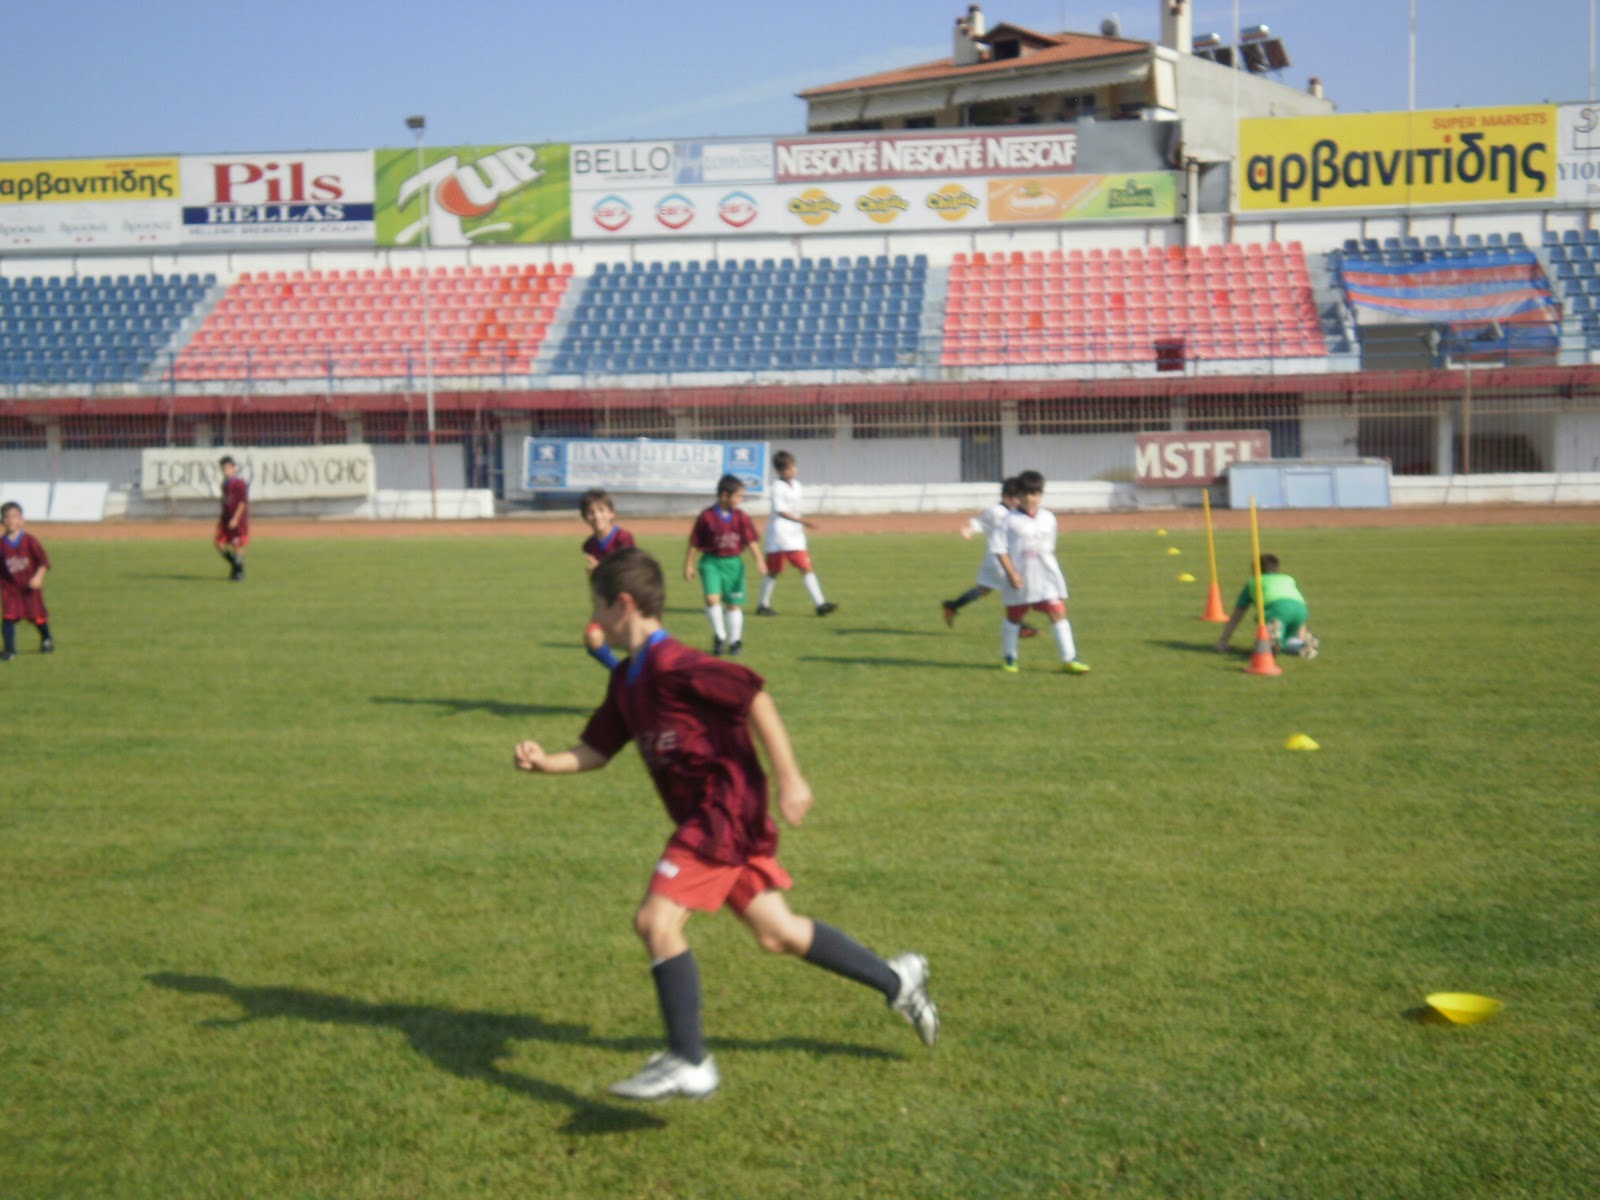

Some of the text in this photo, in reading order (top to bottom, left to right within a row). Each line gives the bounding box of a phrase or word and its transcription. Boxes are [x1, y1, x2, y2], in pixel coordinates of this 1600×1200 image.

[1432, 112, 1547, 130] SUPER MARKETS
[575, 146, 671, 174] BELLO
[1247, 133, 1546, 202] αρβανιτίδης
[0, 169, 174, 201] αρβανιτίδης
[210, 161, 344, 203] Pils
[207, 203, 346, 223] HELLAS
